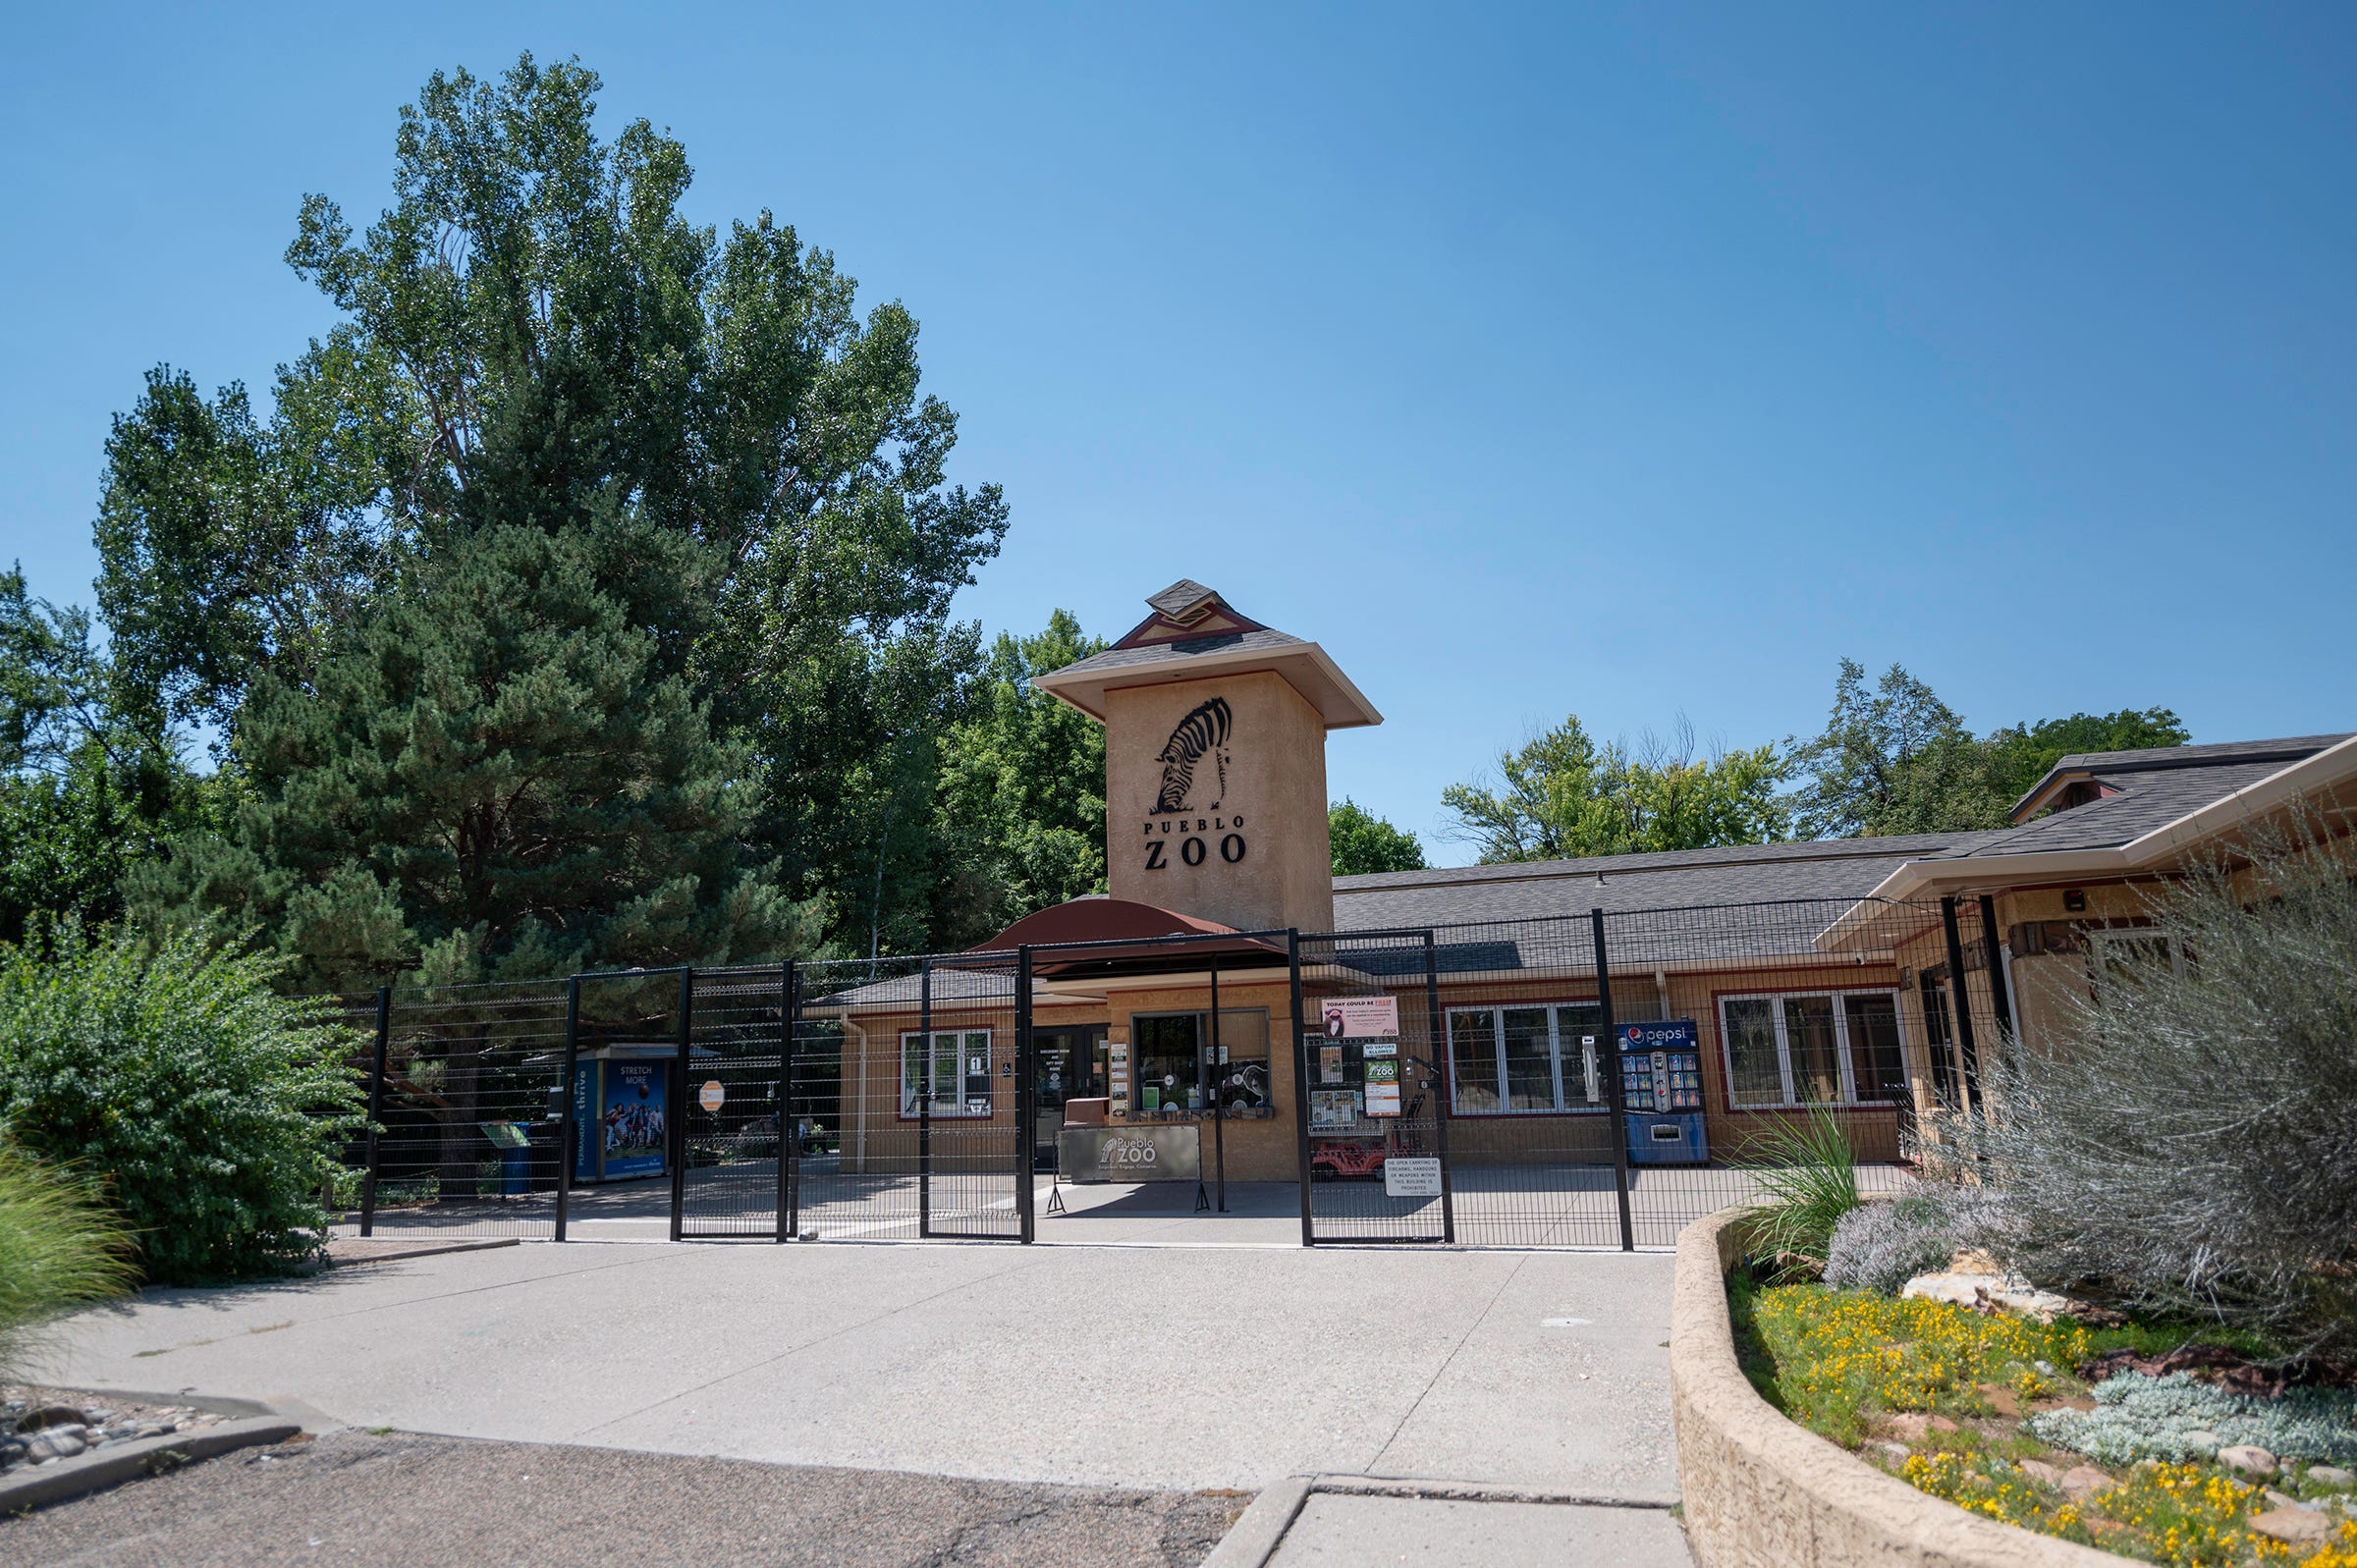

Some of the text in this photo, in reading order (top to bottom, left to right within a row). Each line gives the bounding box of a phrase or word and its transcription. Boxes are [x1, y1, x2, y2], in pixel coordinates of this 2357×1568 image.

[1144, 815, 1243, 835] PUEBLO
[1145, 834, 1246, 870] ZOO
[1646, 1027, 1686, 1043] pepsi
[621, 1066, 652, 1075] STRETCH
[1376, 1067, 1395, 1076] ZOO
[626, 1076, 647, 1085] MORE
[576, 1070, 586, 1109] thrive
[1118, 1137, 1154, 1148] Pueblo
[1118, 1147, 1156, 1163] ZOO
